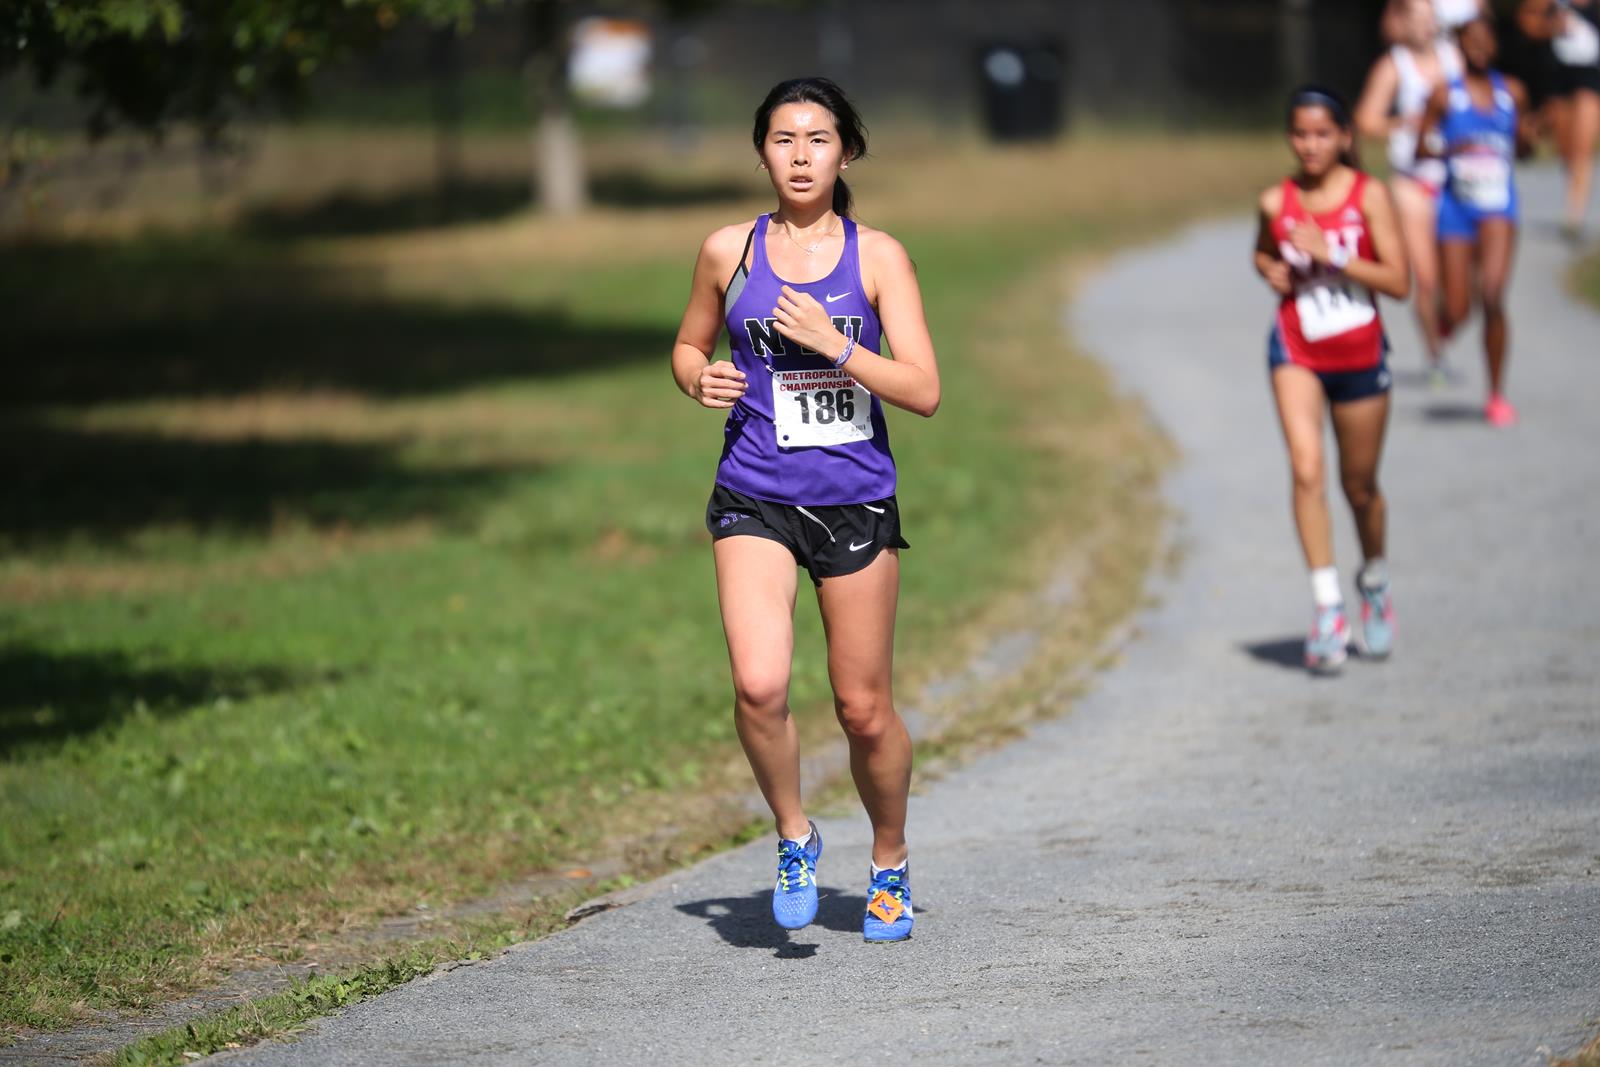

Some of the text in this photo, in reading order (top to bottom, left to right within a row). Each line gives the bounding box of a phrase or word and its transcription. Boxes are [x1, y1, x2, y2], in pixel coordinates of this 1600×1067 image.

[744, 316, 863, 357] NU
[782, 370, 850, 381] METROPOLIT
[795, 389, 855, 425] 186
